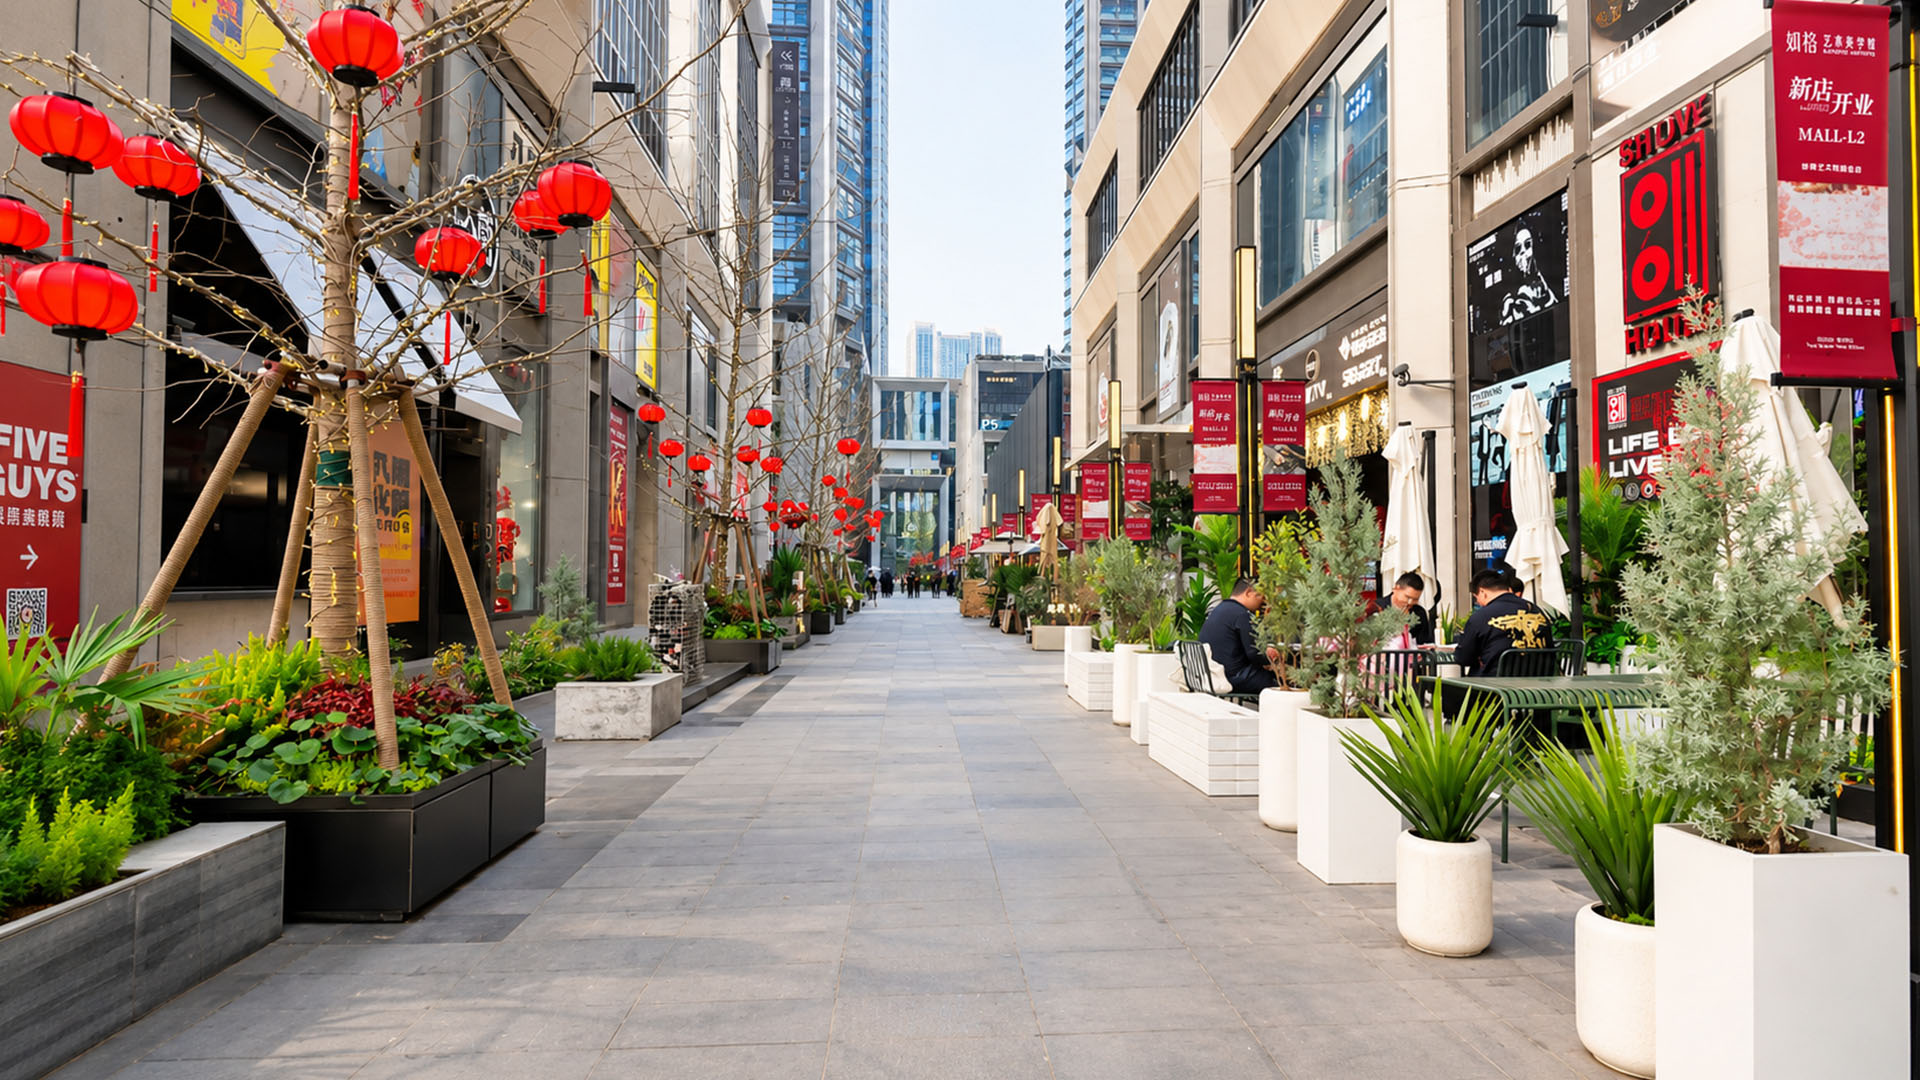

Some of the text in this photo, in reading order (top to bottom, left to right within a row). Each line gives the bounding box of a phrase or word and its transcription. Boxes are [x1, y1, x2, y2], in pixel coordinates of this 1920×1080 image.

[1788, 75, 1875, 116] 新店开业
[1798, 127, 1865, 144] MALL-L2
[0, 424, 69, 466] FIVE
[1608, 430, 1660, 456] LIFE
[0, 463, 77, 503] UYS
